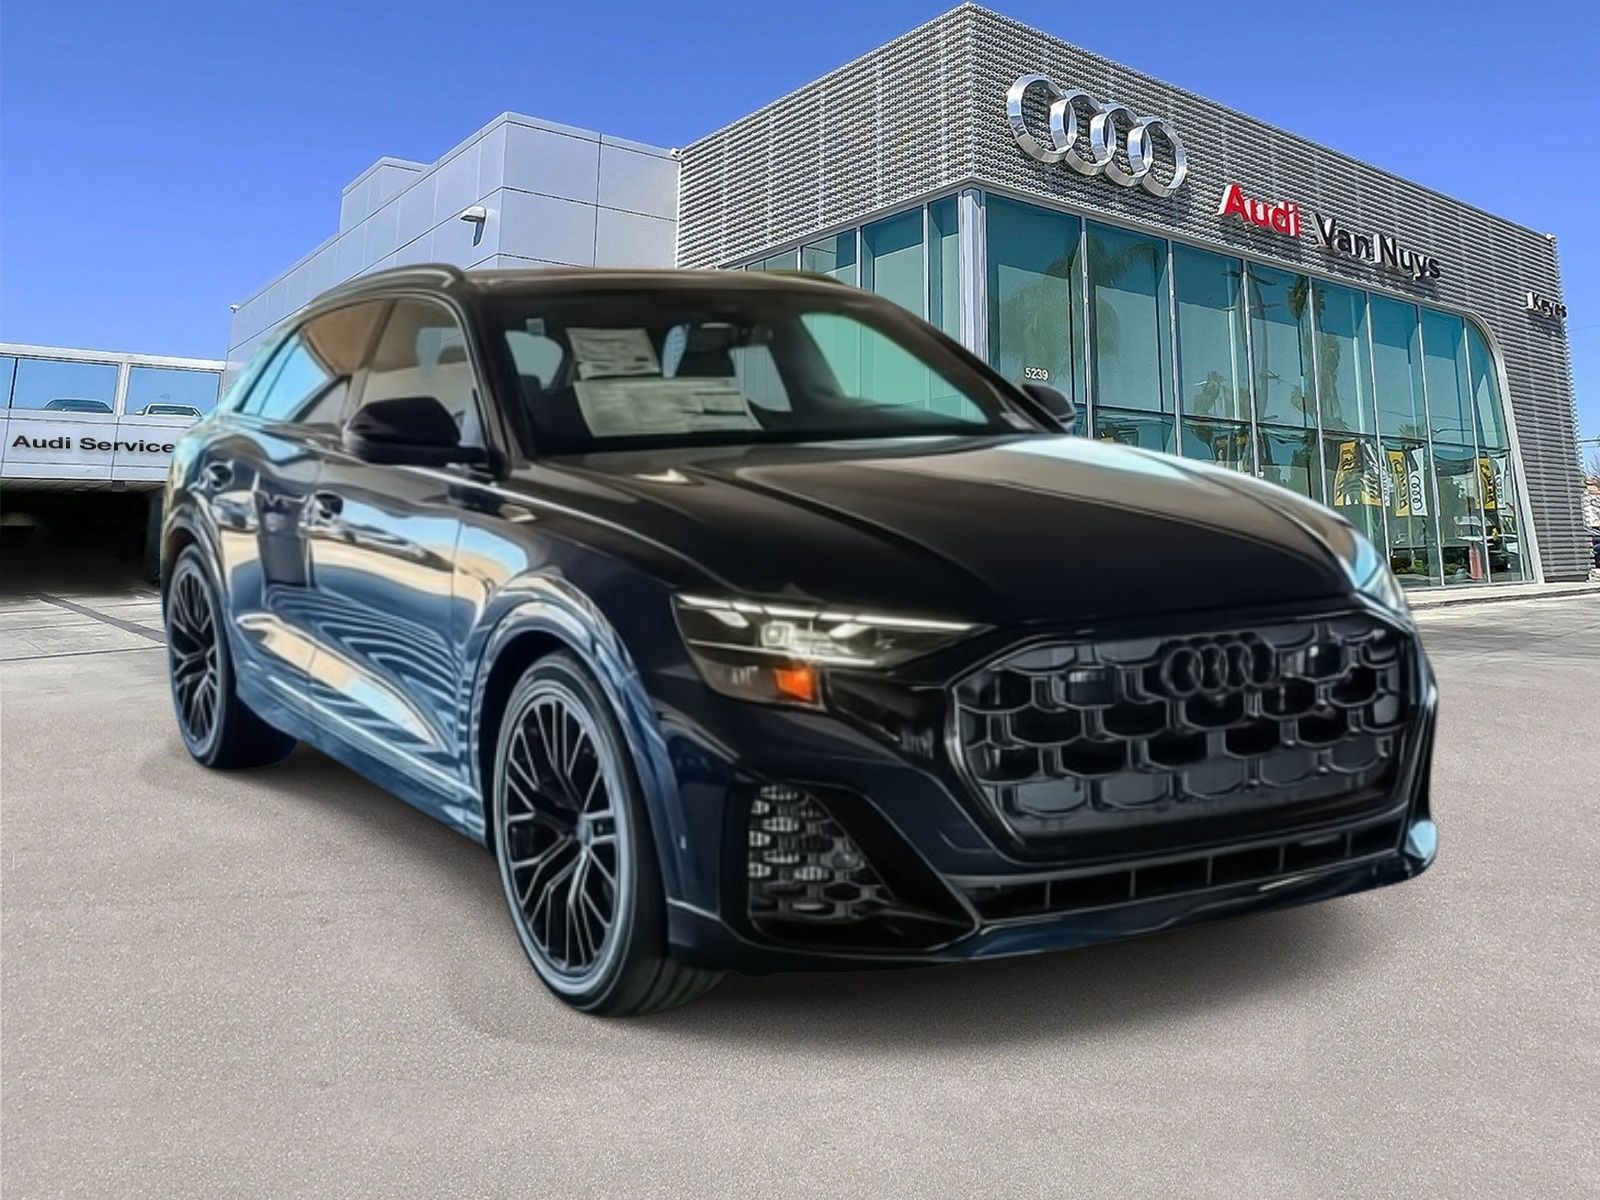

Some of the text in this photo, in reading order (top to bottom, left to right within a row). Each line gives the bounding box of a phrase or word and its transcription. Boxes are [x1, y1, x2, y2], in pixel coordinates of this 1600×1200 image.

[1217, 183, 1441, 281] Audi Van Nuys
[1024, 367, 1048, 380] 5239
[12, 435, 176, 453] Audi Service
